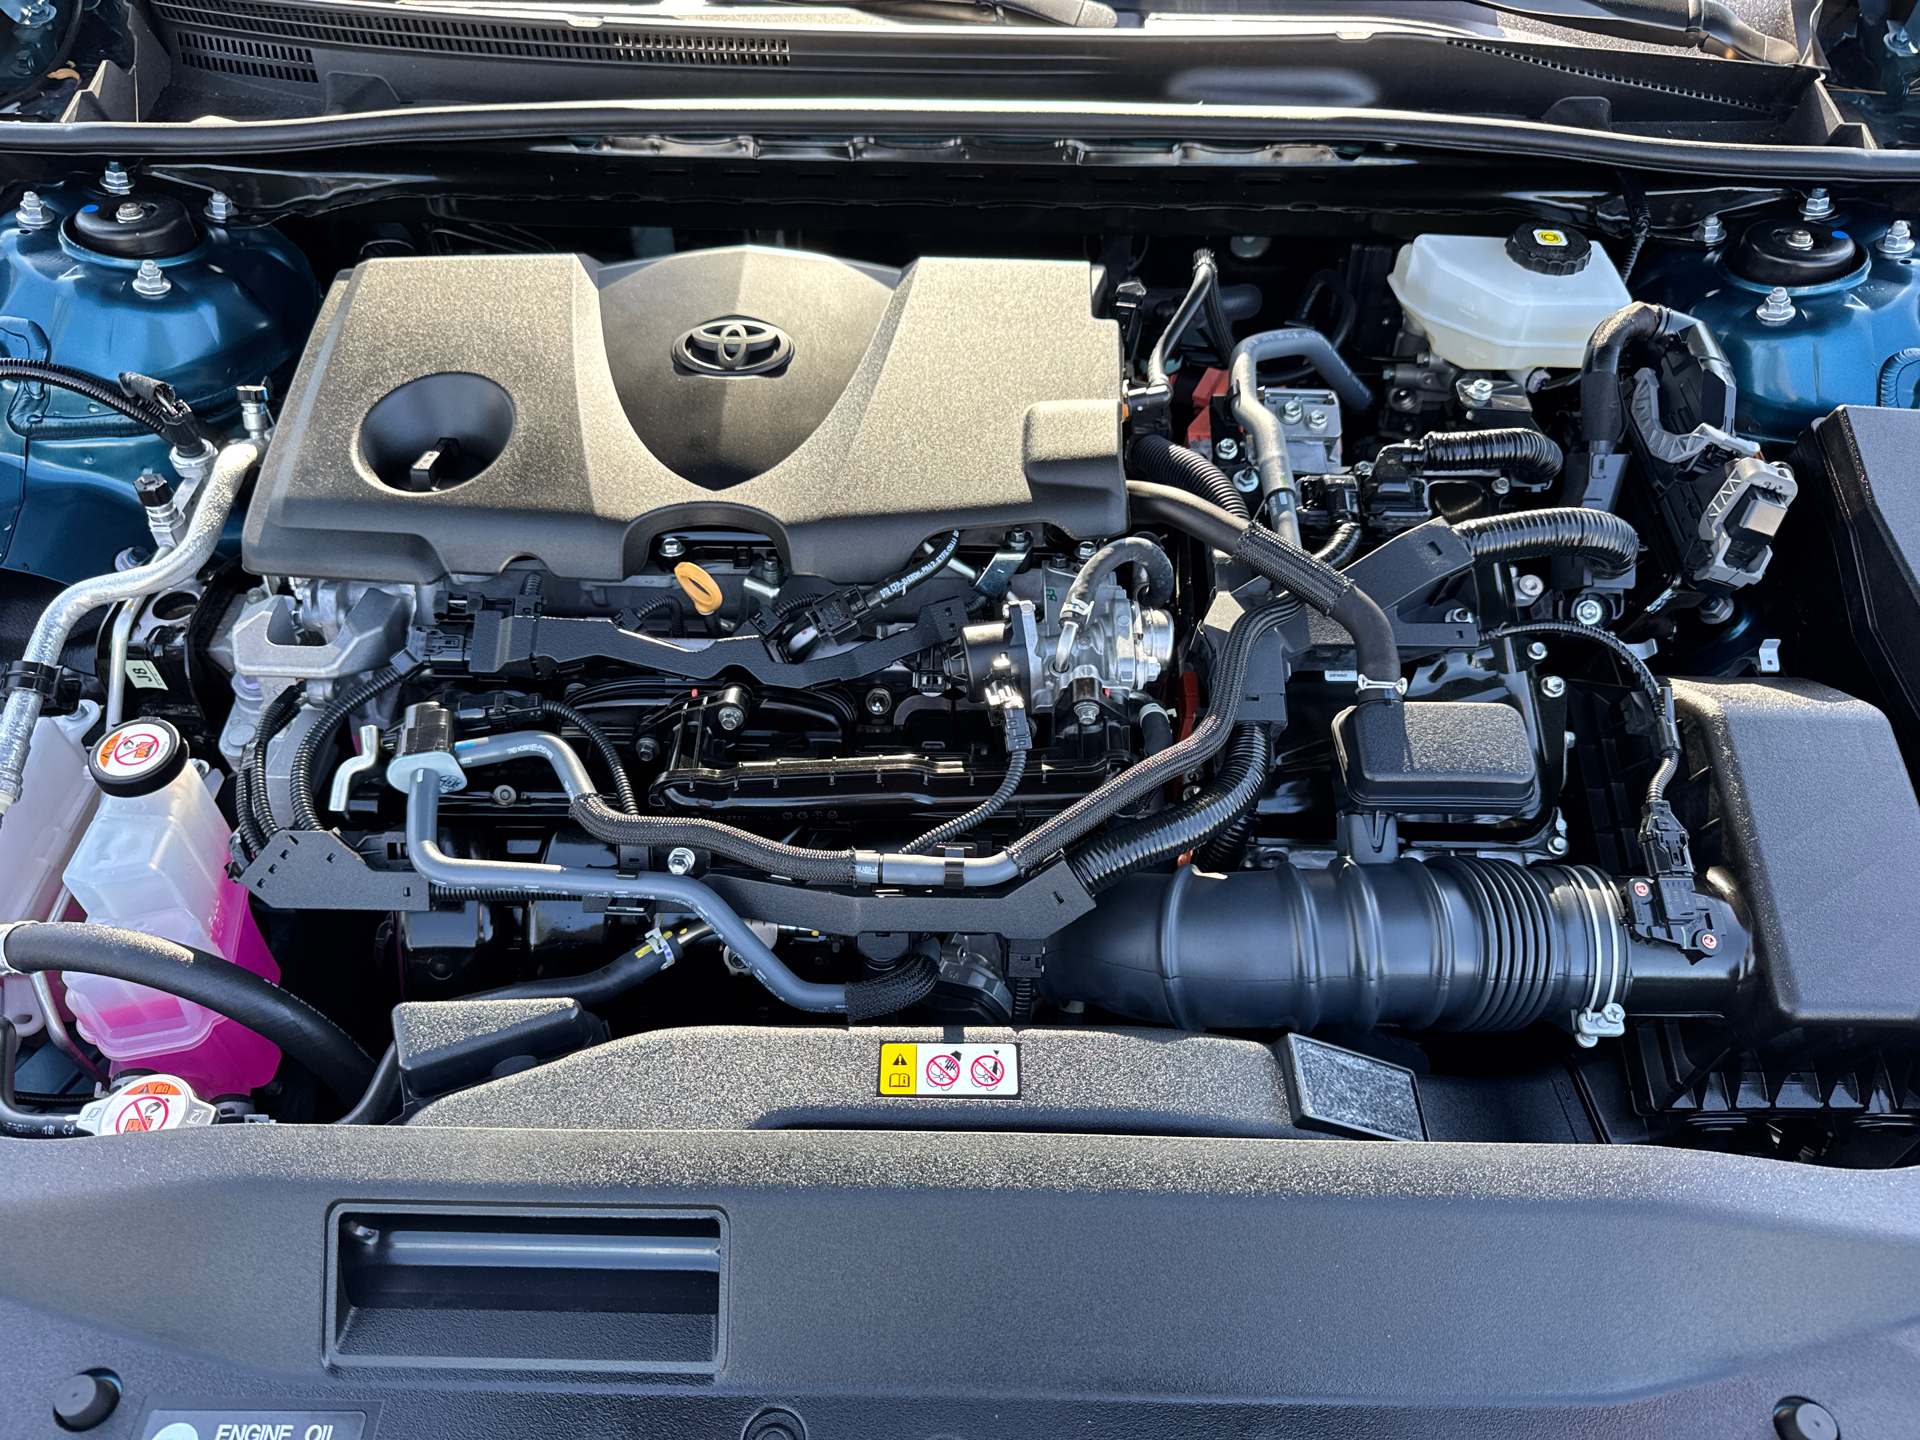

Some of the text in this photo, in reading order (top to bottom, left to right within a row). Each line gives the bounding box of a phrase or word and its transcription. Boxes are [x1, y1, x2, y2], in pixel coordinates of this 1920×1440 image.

[132, 667, 152, 682] J8
[214, 1424, 334, 1440] ENGINE OIL
